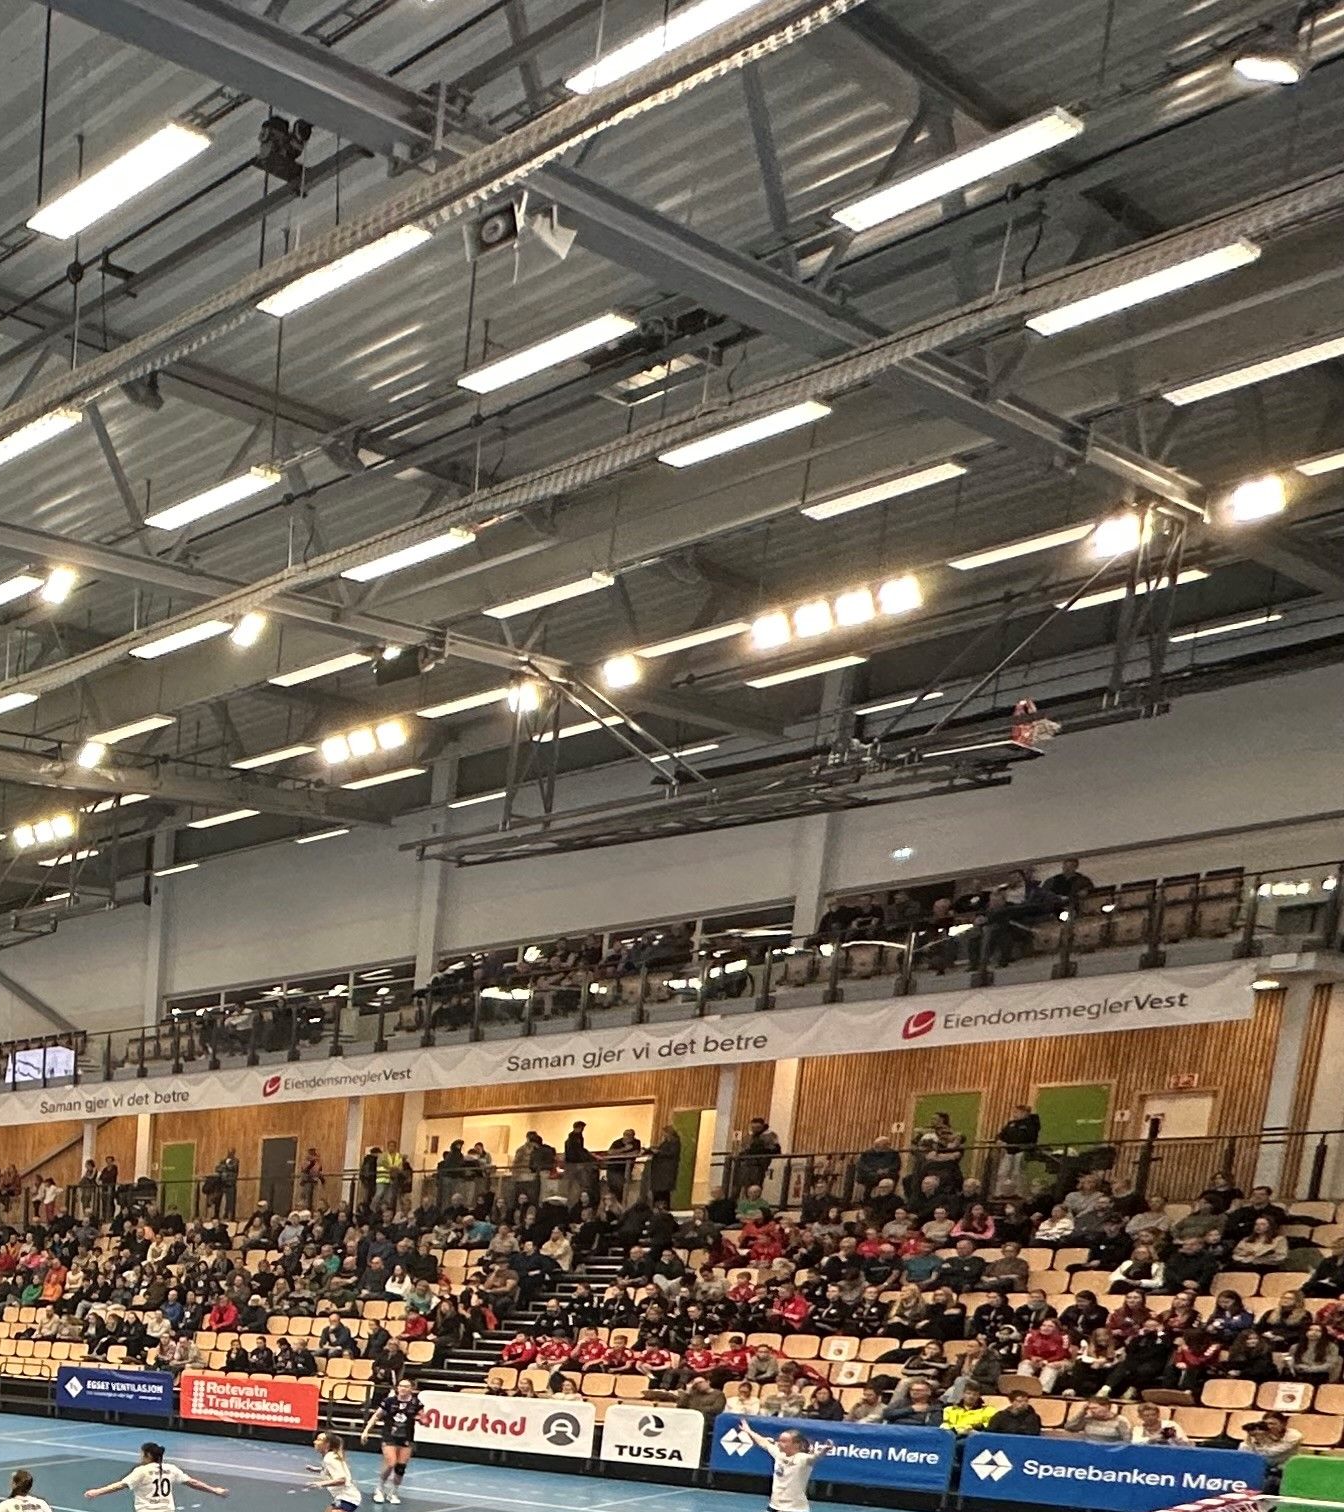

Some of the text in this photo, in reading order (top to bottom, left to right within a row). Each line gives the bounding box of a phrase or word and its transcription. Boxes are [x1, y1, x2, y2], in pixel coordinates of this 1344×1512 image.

[943, 992, 1189, 1030] EiendomsmeglerVest
[506, 1034, 768, 1072] Saman gjer vi det betre
[284, 1068, 412, 1090] EiendomsmeglerVest
[40, 1090, 190, 1114] Saman gjer vi det betre
[86, 1379, 164, 1395] EGSET VENTILASJON
[206, 1380, 269, 1398] Rotevatn
[206, 1395, 291, 1414] Trafikkskole
[614, 1444, 684, 1462] TUSSA
[887, 1447, 939, 1465] Møre
[1022, 1460, 1248, 1493] Sparebanken Møre
[152, 1478, 171, 1497] 10
